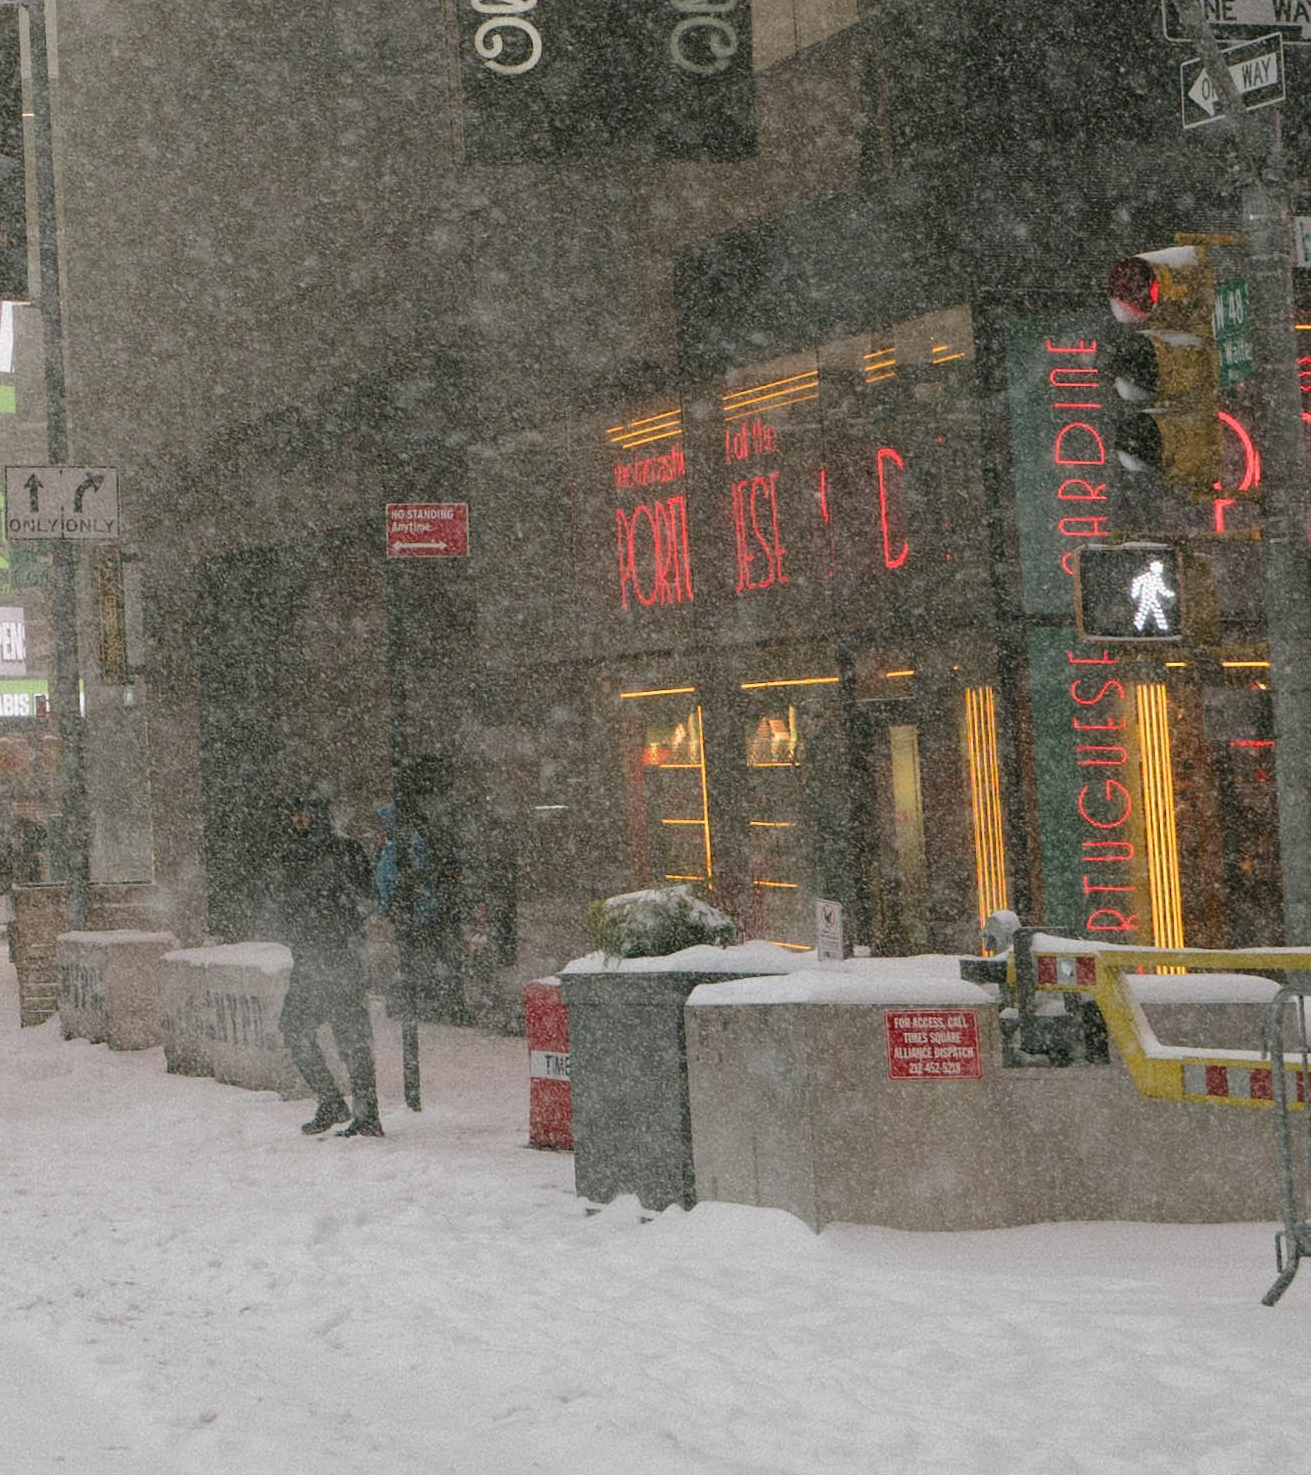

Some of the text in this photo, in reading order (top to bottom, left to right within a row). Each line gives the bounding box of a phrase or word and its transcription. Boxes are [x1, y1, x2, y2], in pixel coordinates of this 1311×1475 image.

[1242, 57, 1272, 90] WAY
[1228, 288, 1244, 325] 48
[391, 508, 455, 520] NO STANDING
[9, 517, 116, 534] ONLY ONLY
[893, 1017, 911, 1029] FOR
[947, 1016, 969, 1028] CALL
[903, 1031, 962, 1044] TIMES SQUARE
[894, 1046, 975, 1059] ALLIANCE DISPATCH
